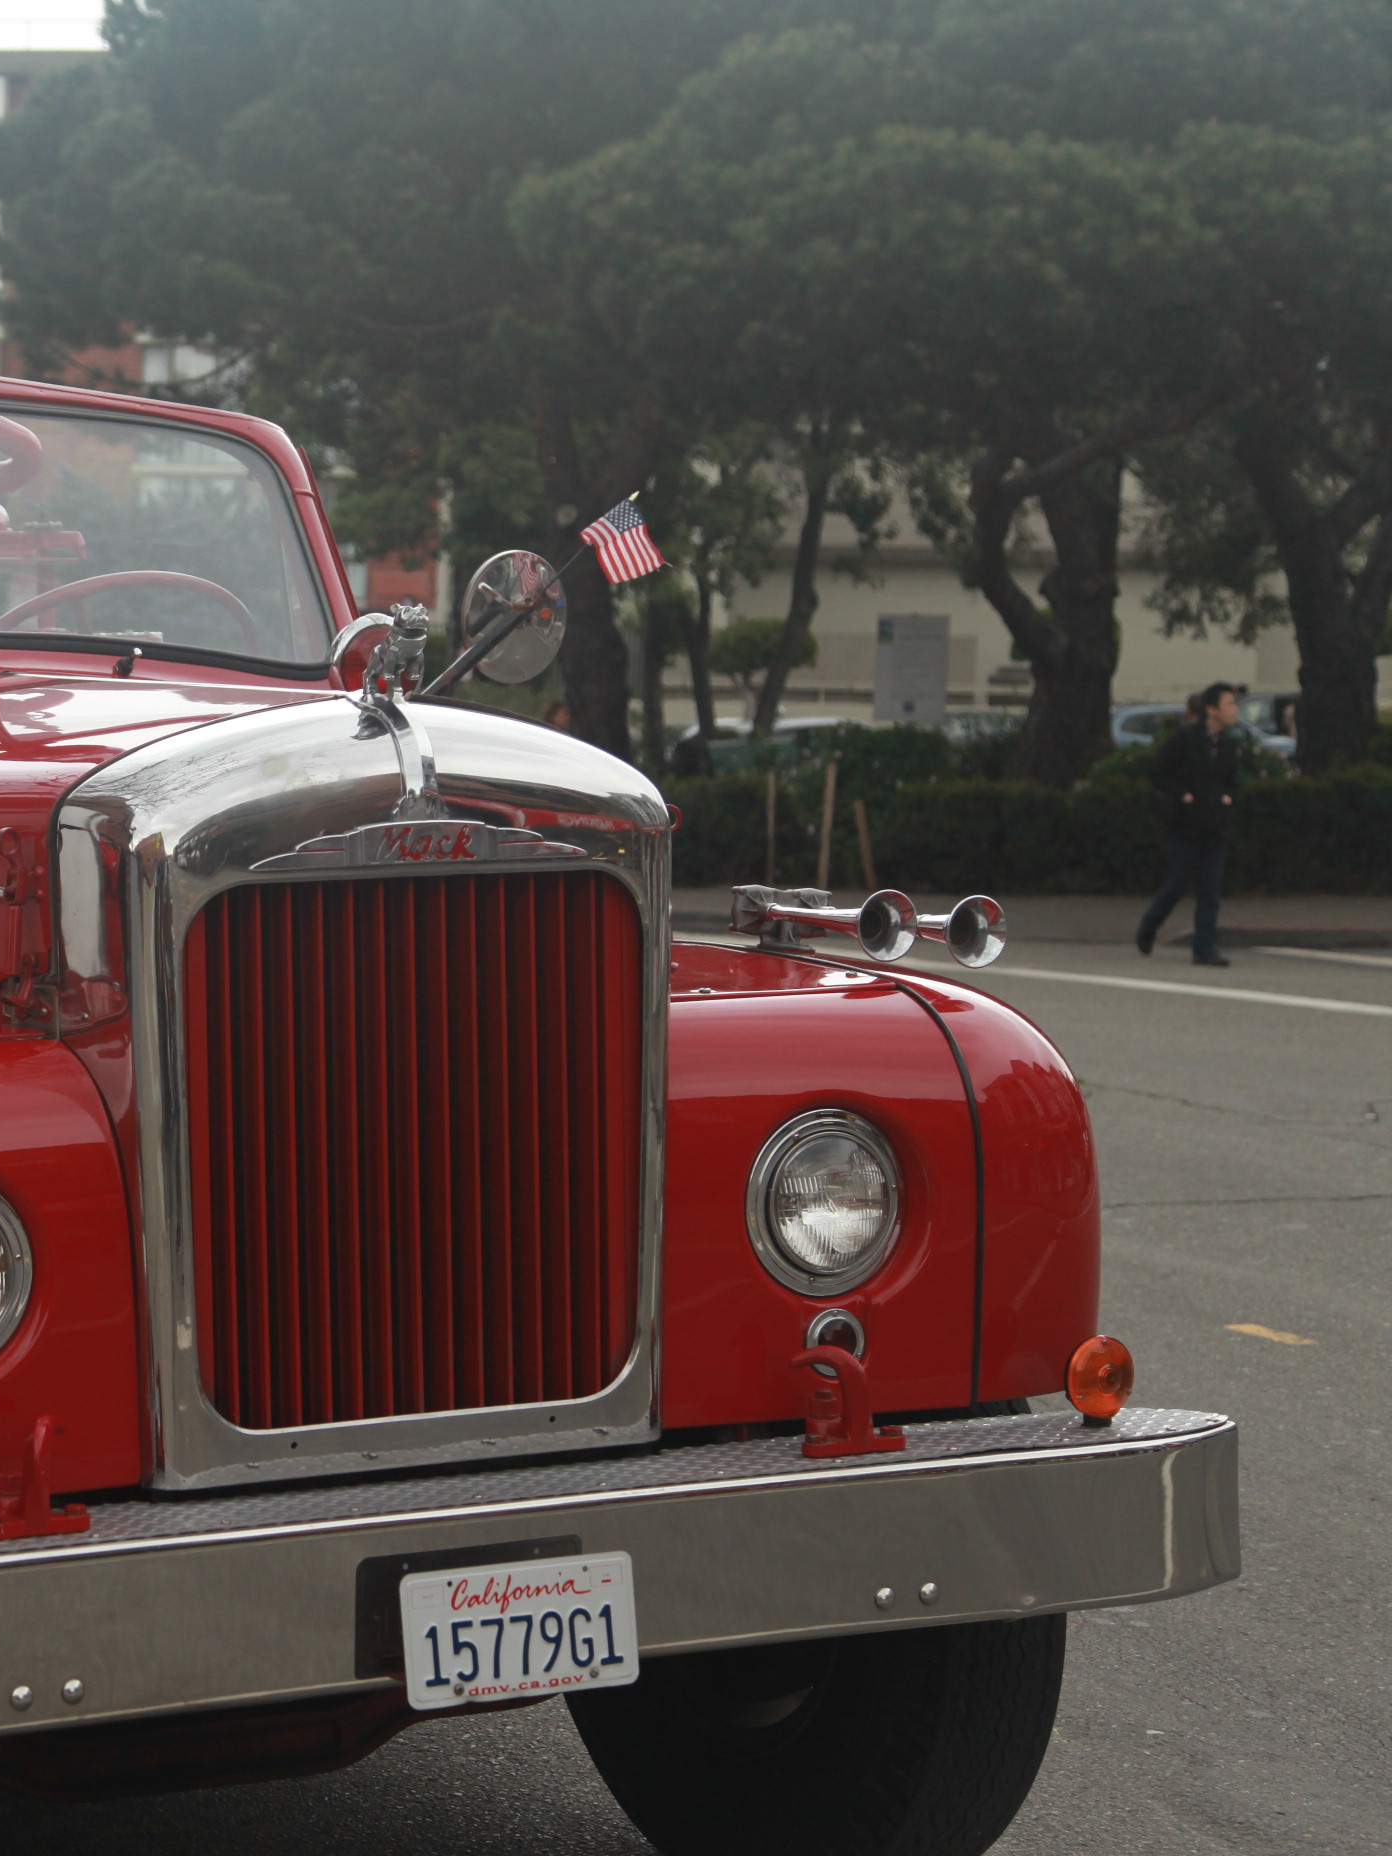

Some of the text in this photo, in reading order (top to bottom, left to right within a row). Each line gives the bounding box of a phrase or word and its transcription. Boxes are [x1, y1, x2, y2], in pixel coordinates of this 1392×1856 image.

[370, 824, 477, 865] Mack
[450, 1571, 592, 1614] California
[424, 1604, 624, 1687] 15779G1
[467, 1674, 585, 1697] dmv.ca.gov
